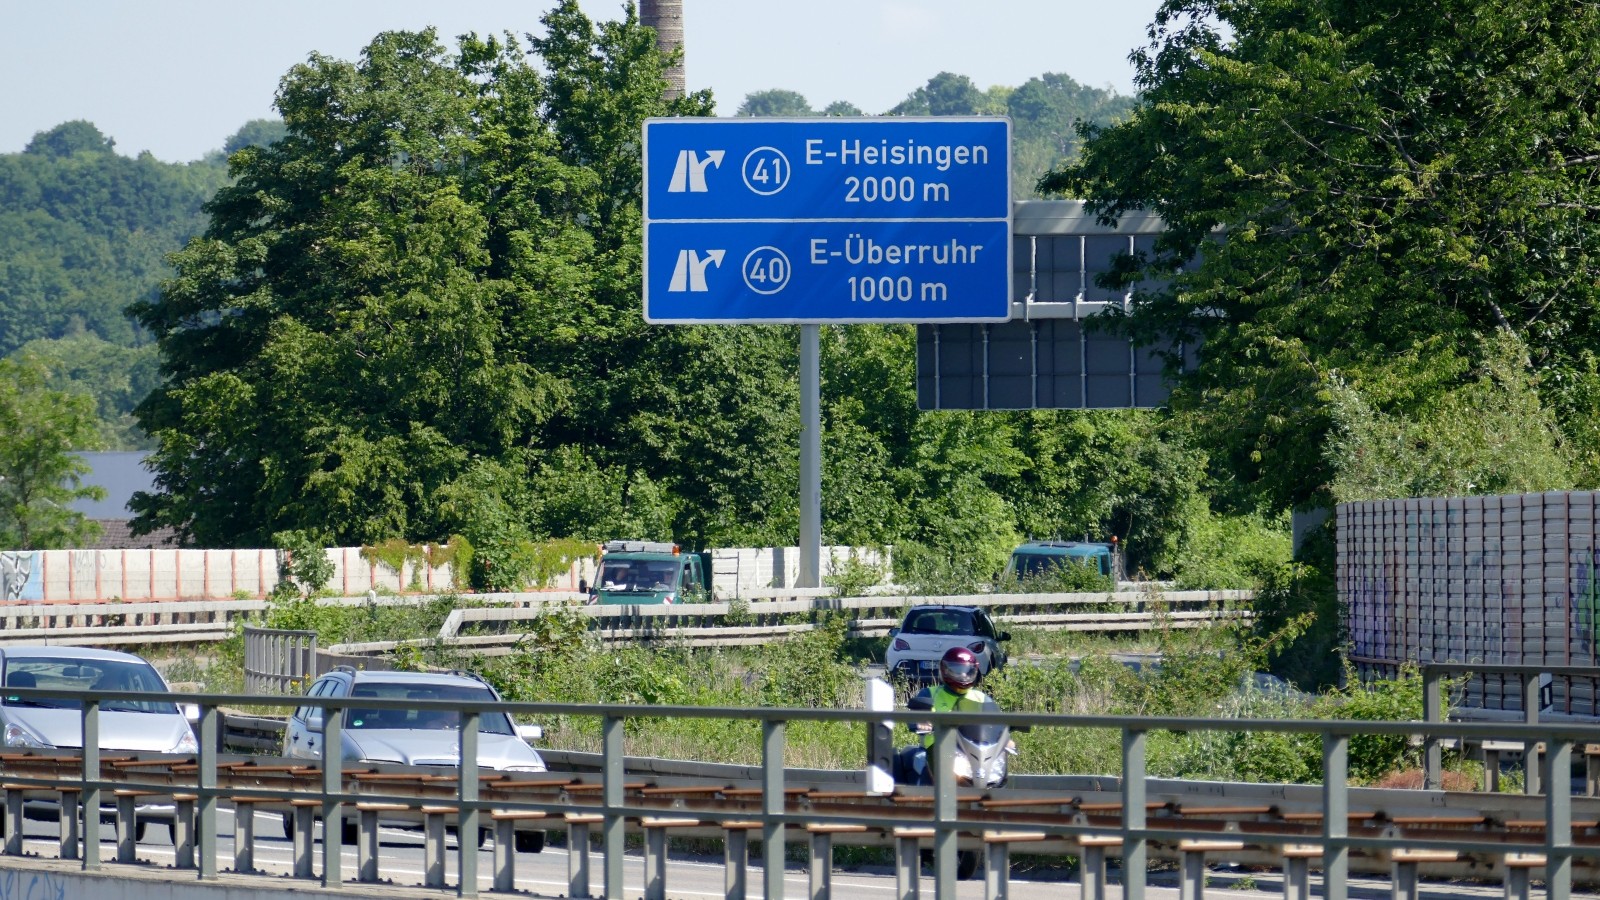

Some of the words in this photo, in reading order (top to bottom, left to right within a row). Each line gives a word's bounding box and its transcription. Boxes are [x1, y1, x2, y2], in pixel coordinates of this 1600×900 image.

[806, 139, 988, 171] E-Heisingen
[752, 158, 781, 184] 41
[845, 176, 915, 202] 2000
[923, 182, 949, 202] m
[810, 233, 983, 264] E-Überruhr
[750, 257, 784, 283] 40
[848, 276, 912, 301] 1000
[921, 282, 947, 301] m
